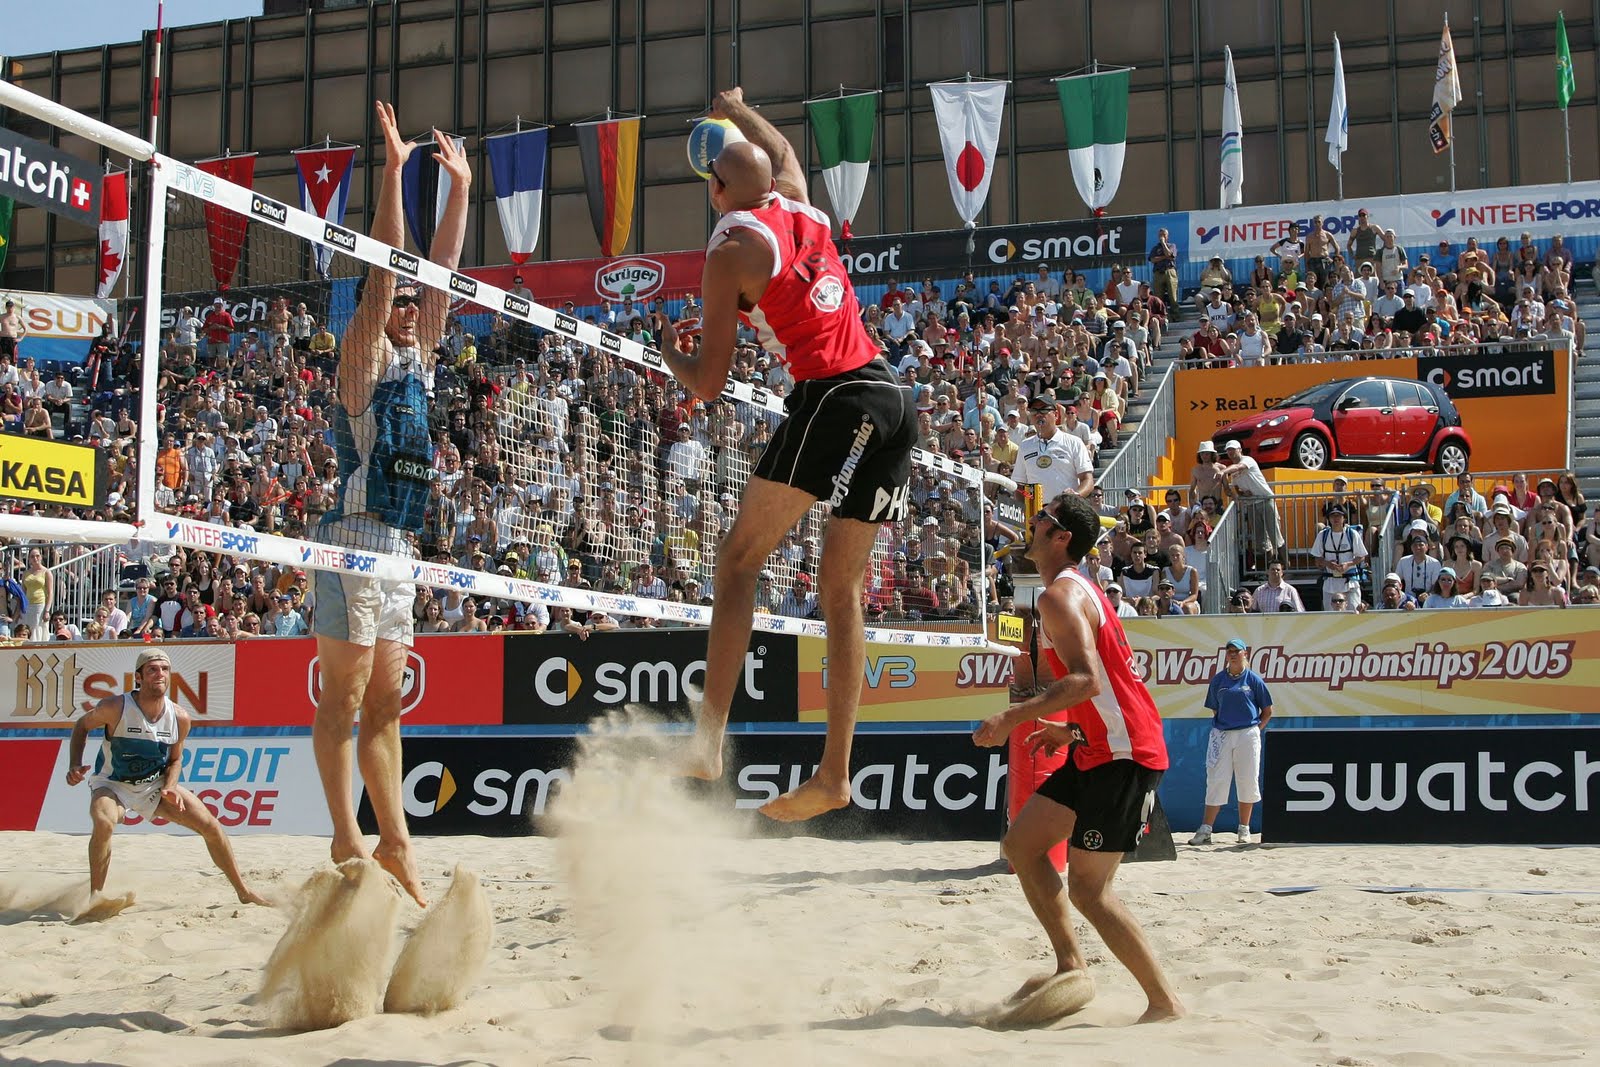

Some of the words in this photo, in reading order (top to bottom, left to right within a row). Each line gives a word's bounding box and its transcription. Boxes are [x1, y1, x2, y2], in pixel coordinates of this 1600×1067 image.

[0, 146, 68, 203] atch
[261, 202, 285, 220] smart
[1461, 199, 1600, 226] INTERSPOR
[333, 232, 354, 248] smart
[1023, 230, 1121, 260] smart
[398, 256, 417, 272] smart
[458, 280, 476, 294] smart
[603, 268, 656, 286] Krüger
[511, 301, 529, 314] smart
[560, 320, 576, 332] smart
[1457, 362, 1543, 388] smart
[1216, 395, 1257, 411] Real
[1, 460, 86, 498] KASA
[182, 525, 258, 555] INTERSPORT
[313, 549, 377, 573] INTERSPORT
[422, 567, 476, 590] INTERSPORT
[514, 583, 563, 602] INTERSPORT
[957, 653, 1013, 686] SWA
[1157, 648, 1243, 682] Worl
[1252, 644, 1476, 687] Championships
[1480, 642, 1570, 676] 2005
[11, 653, 83, 718] Bit
[593, 652, 764, 703] smat
[178, 747, 290, 783] REDIT
